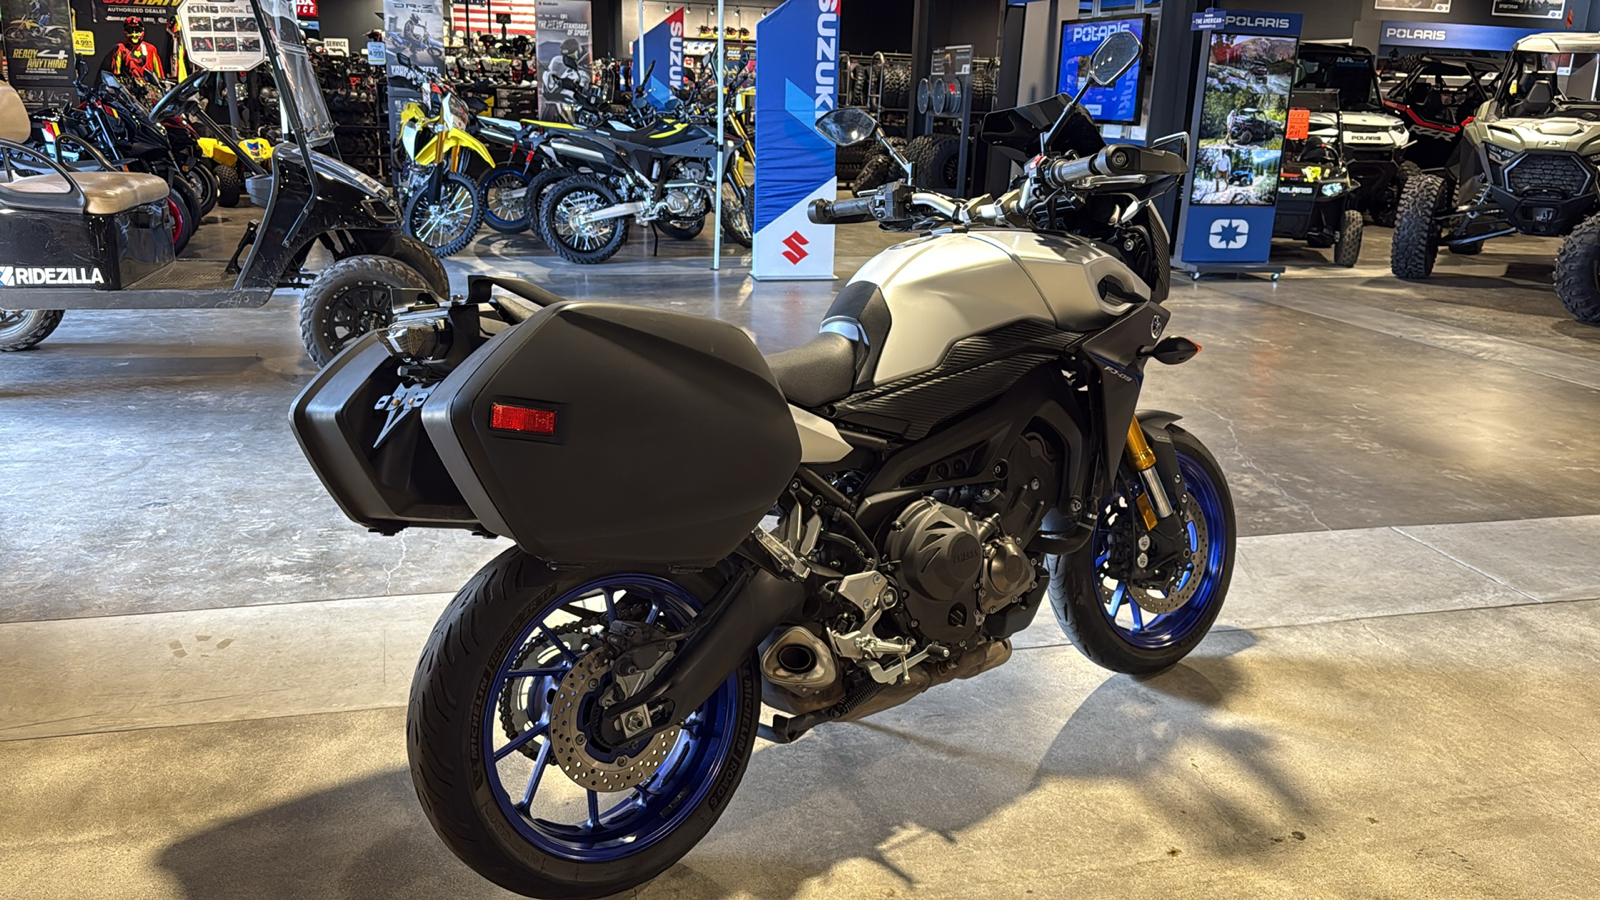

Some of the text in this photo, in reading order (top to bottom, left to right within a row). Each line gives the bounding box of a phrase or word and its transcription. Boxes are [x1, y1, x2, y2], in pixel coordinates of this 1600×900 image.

[1225, 15, 1290, 29] POLARIS
[574, 29, 590, 37] SPORT
[1386, 27, 1446, 41] POLARIS
[326, 40, 347, 48] SERVICE
[12, 48, 39, 58] READY
[669, 21, 683, 99] SUZUK
[26, 59, 68, 69] ANYTHING
[1409, 125, 1457, 143] RZR
[15, 267, 104, 284] RIDEZILLA
[470, 679, 489, 760] MICHELIN
[735, 680, 752, 753] MICHELIN
[717, 758, 739, 799] ROAD
